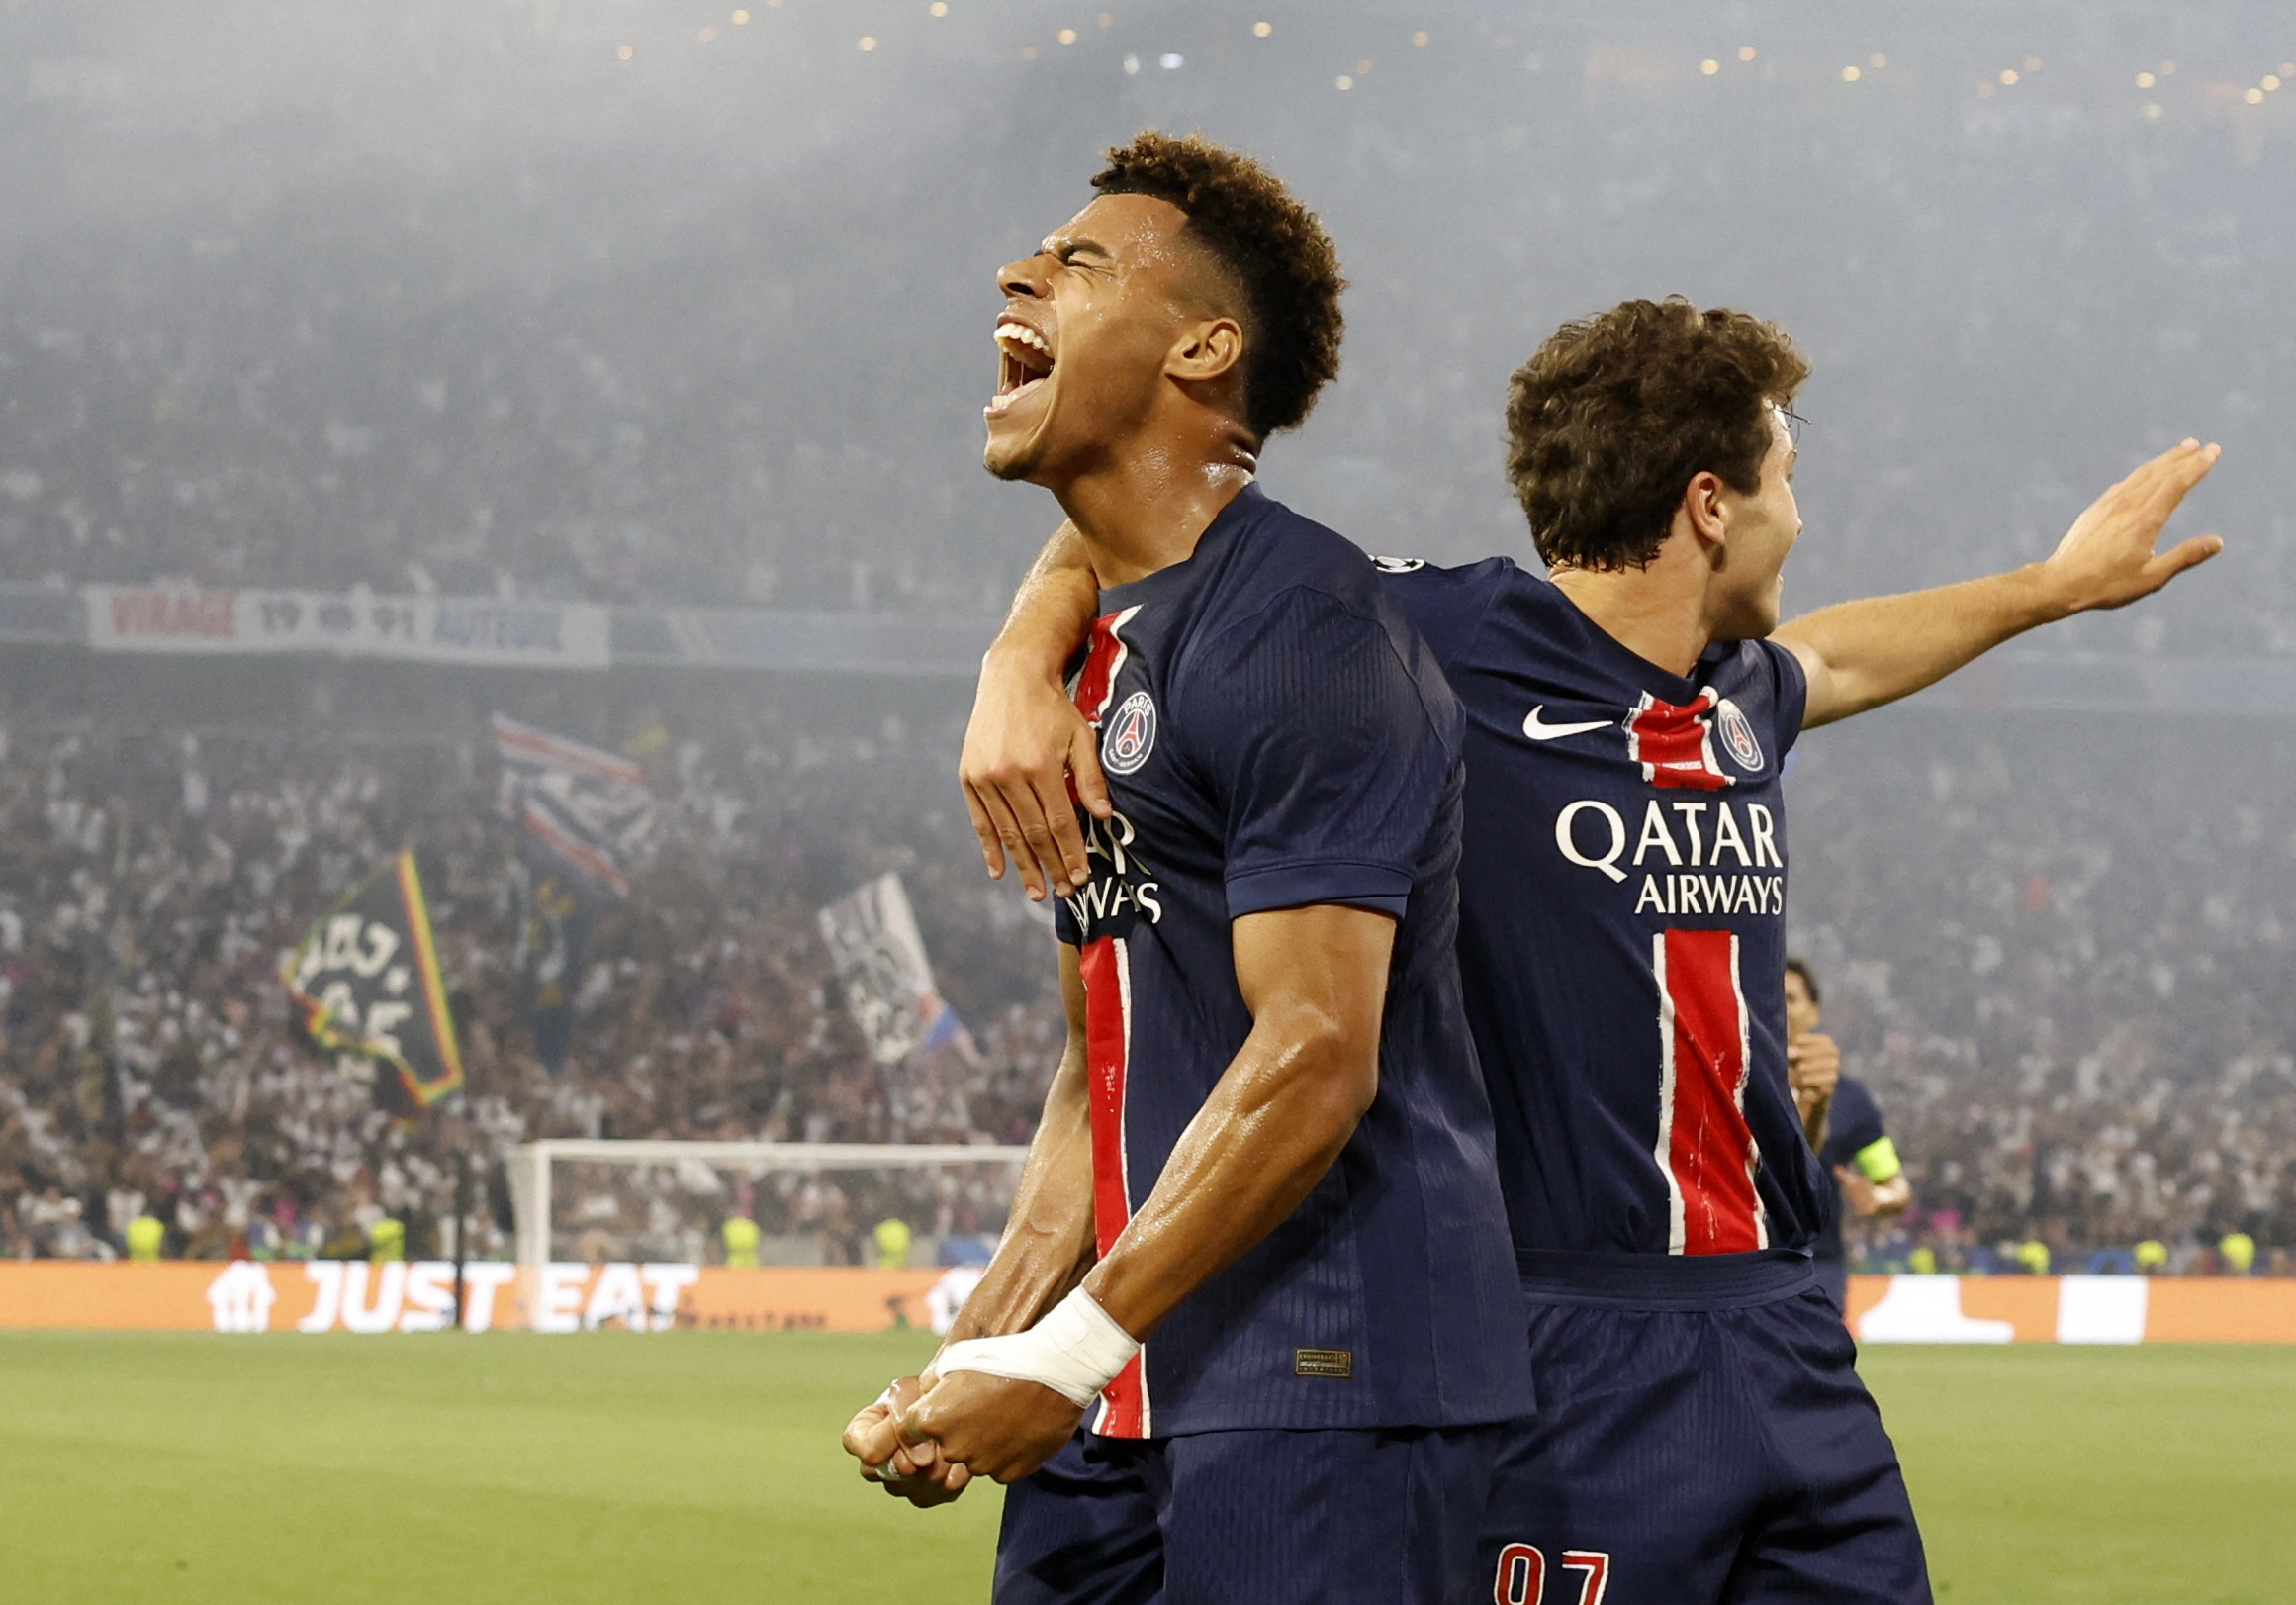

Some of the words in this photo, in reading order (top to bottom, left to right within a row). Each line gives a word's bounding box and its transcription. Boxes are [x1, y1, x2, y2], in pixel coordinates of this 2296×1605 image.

[1124, 696, 1151, 716] PARIS
[1555, 800, 1783, 883] QATAR
[1634, 874, 1783, 915] AIRWAYS
[298, 1260, 516, 1333] JUST
[531, 1261, 701, 1333] EAT
